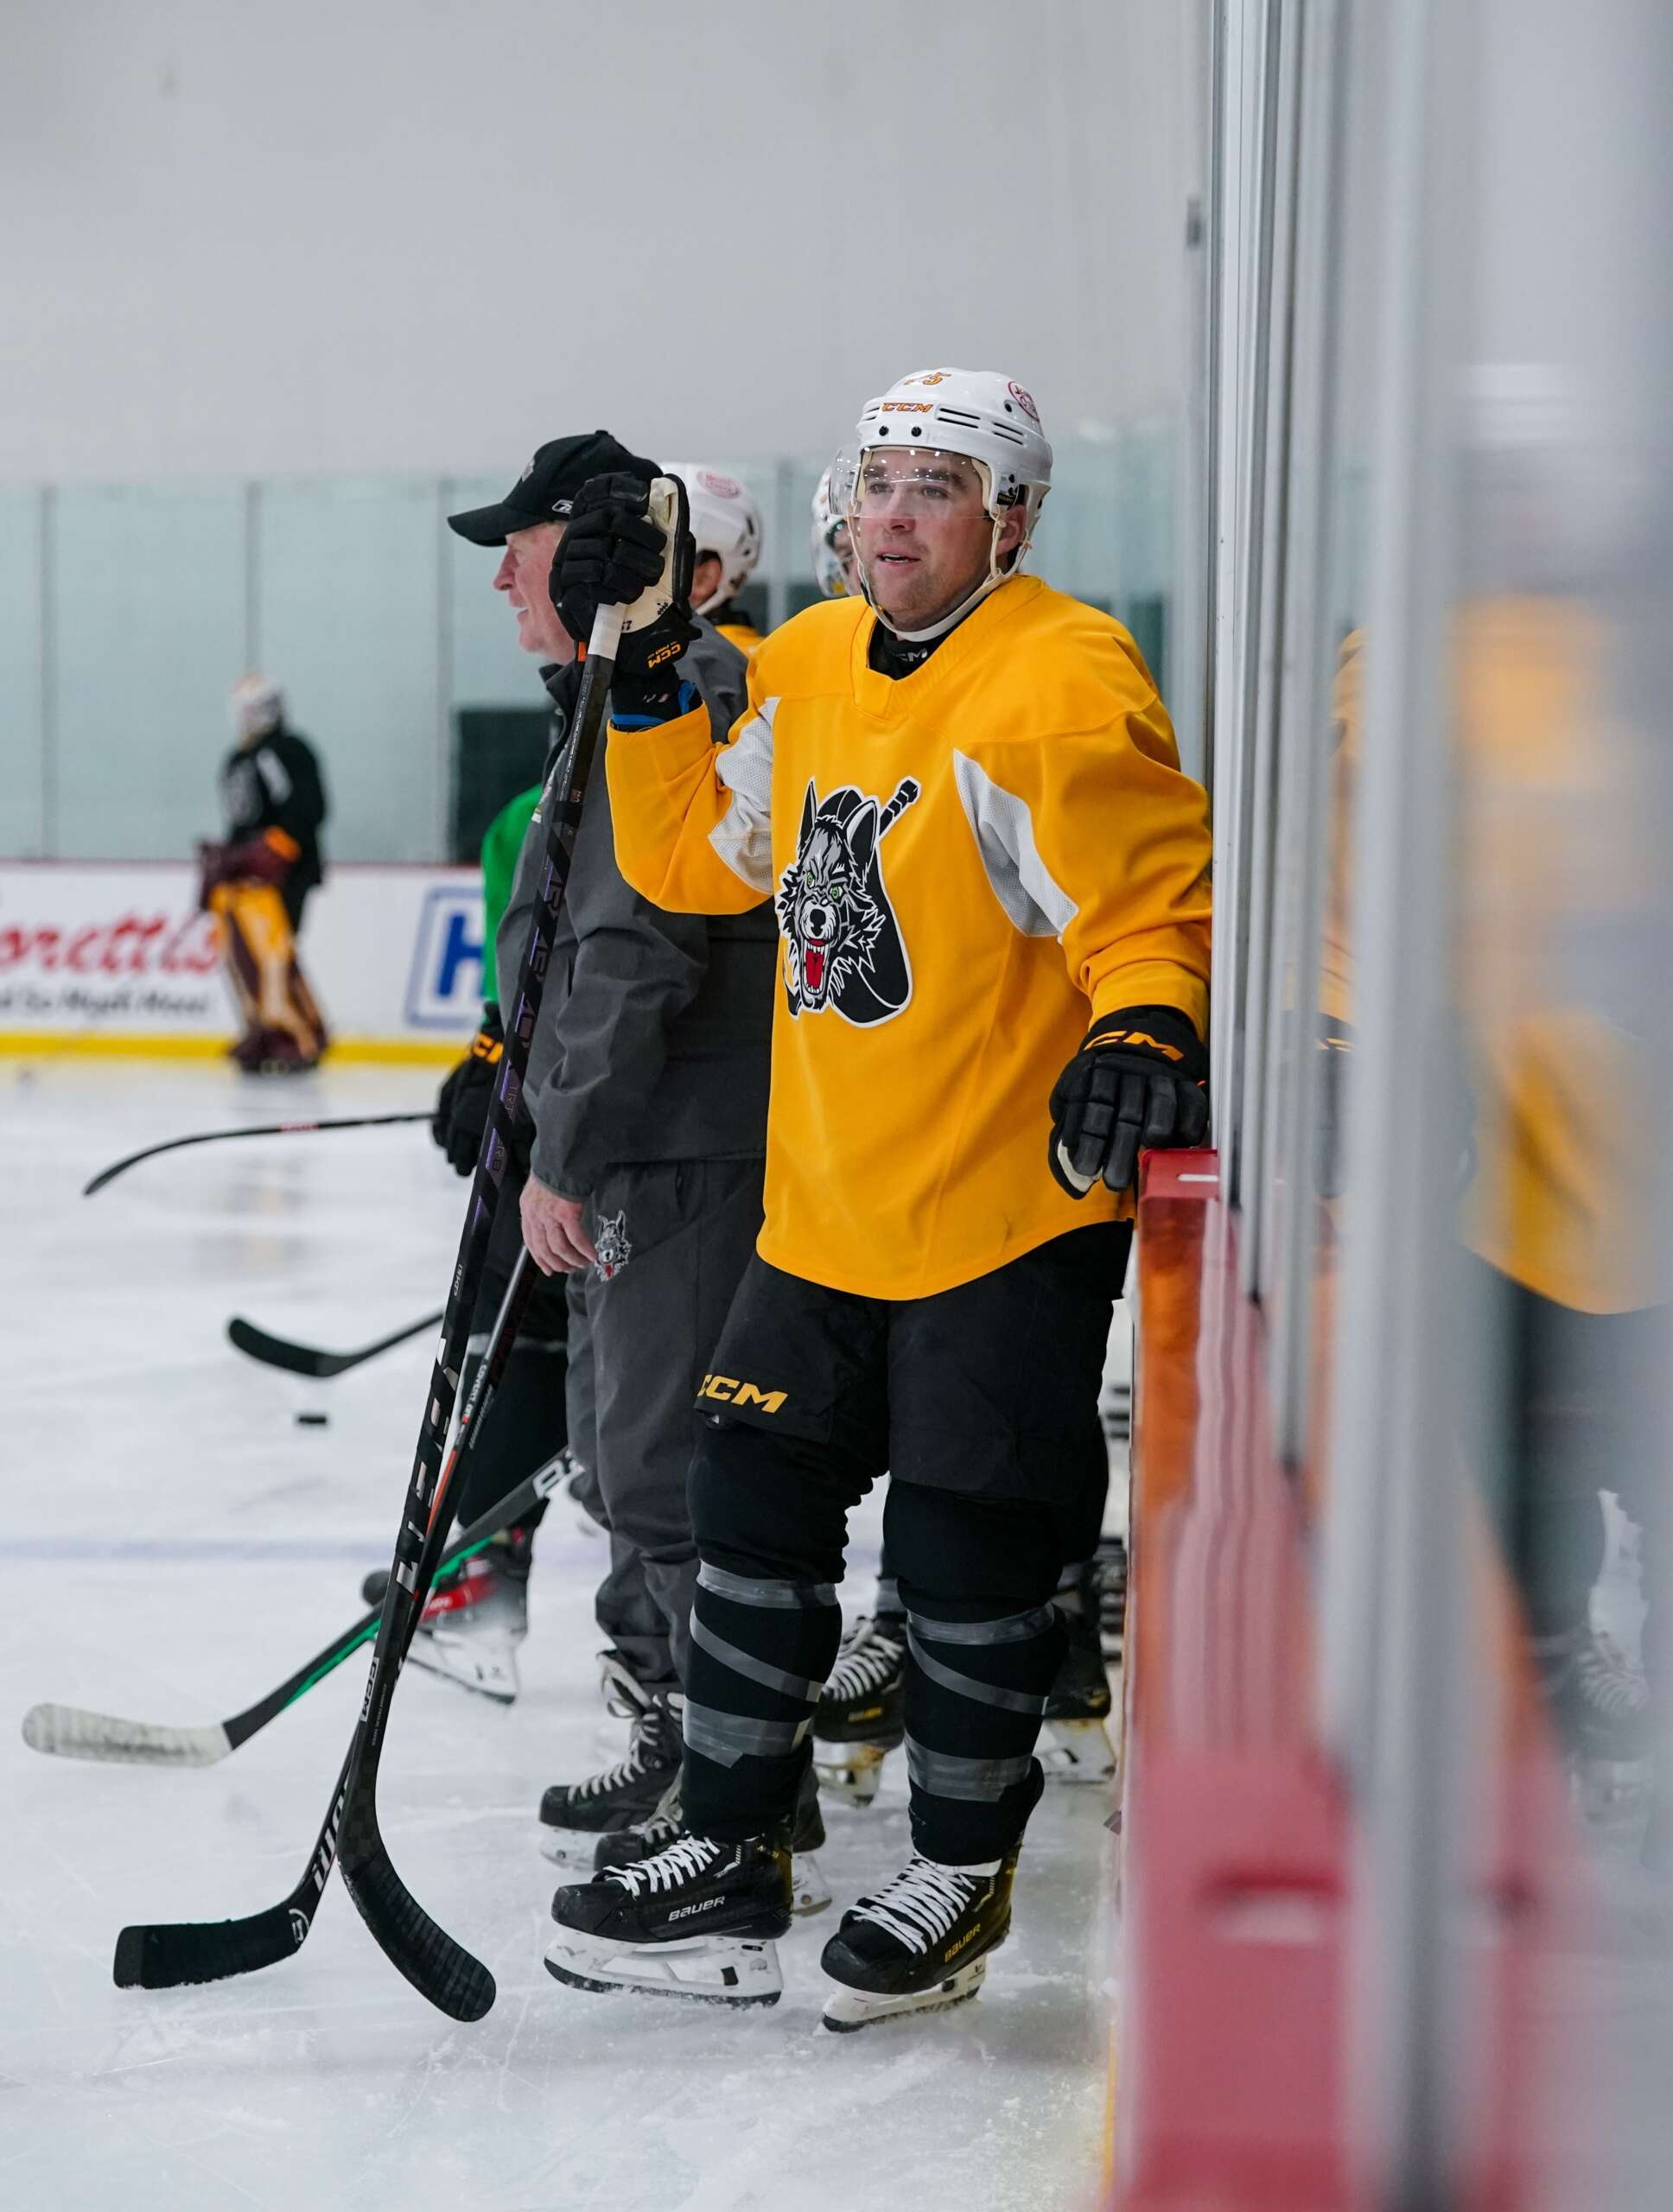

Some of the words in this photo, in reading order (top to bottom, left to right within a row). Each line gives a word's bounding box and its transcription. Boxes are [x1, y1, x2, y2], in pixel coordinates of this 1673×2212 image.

[881, 402, 934, 413] CCM
[647, 643, 681, 670] CCM
[361, 1661, 377, 1716] CCM
[667, 1894, 726, 1923] BAUER
[944, 1922, 982, 1965] BAUER
